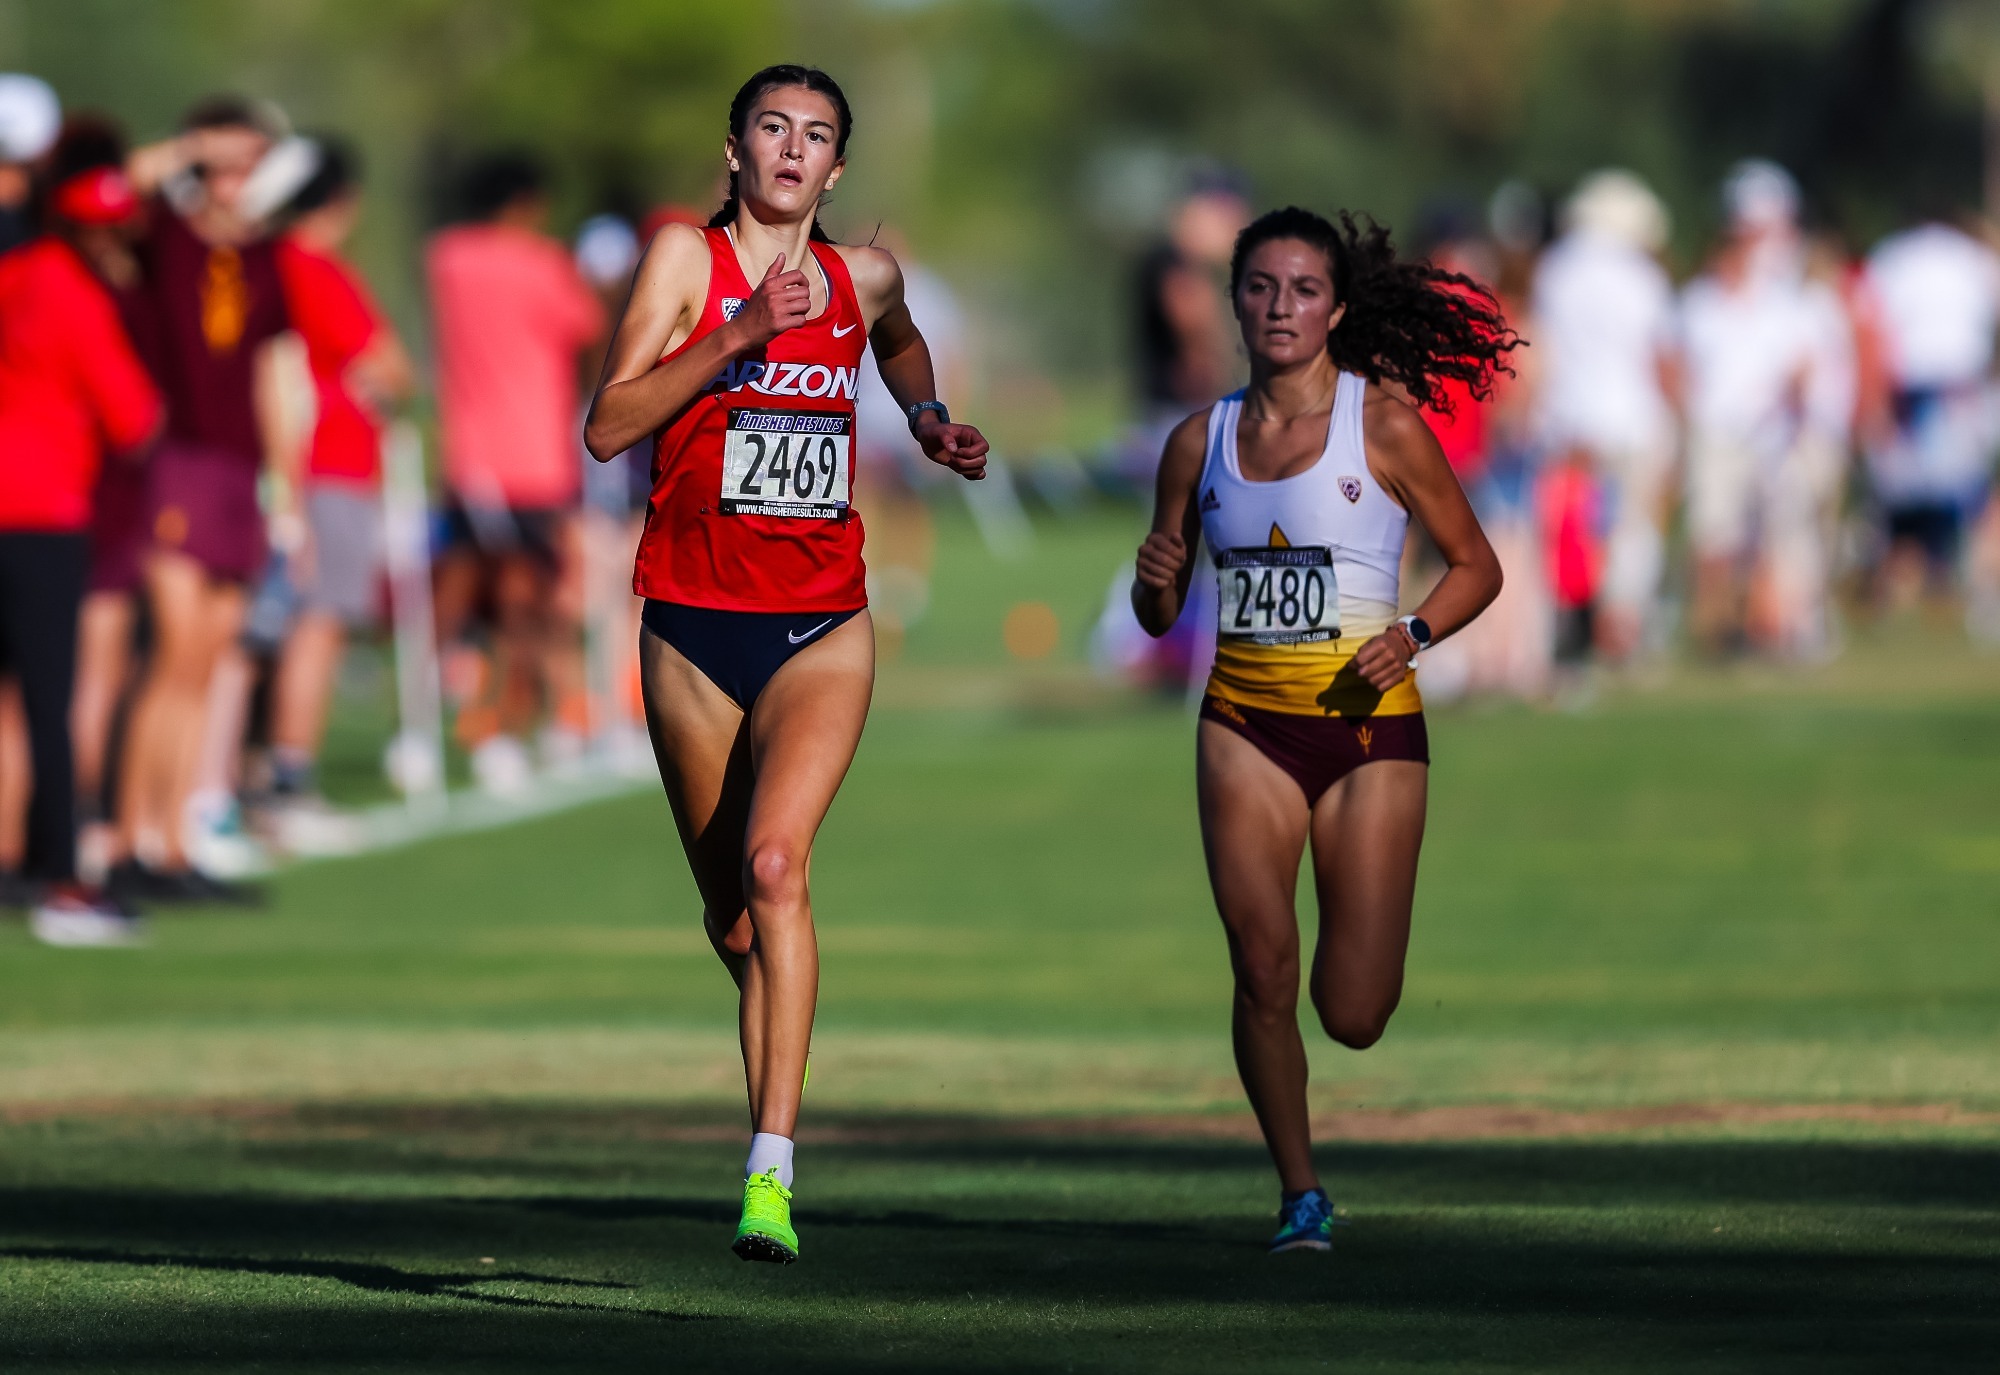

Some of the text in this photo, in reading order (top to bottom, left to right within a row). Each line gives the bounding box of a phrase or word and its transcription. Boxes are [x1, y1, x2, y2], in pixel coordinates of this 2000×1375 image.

[700, 360, 859, 400] ARIZON
[735, 411, 844, 434] FINISHED RESULTS
[740, 433, 837, 499] 2469
[736, 503, 838, 519] WWW.FINISHEDRESULTS.COM
[1235, 568, 1325, 628] 2480
